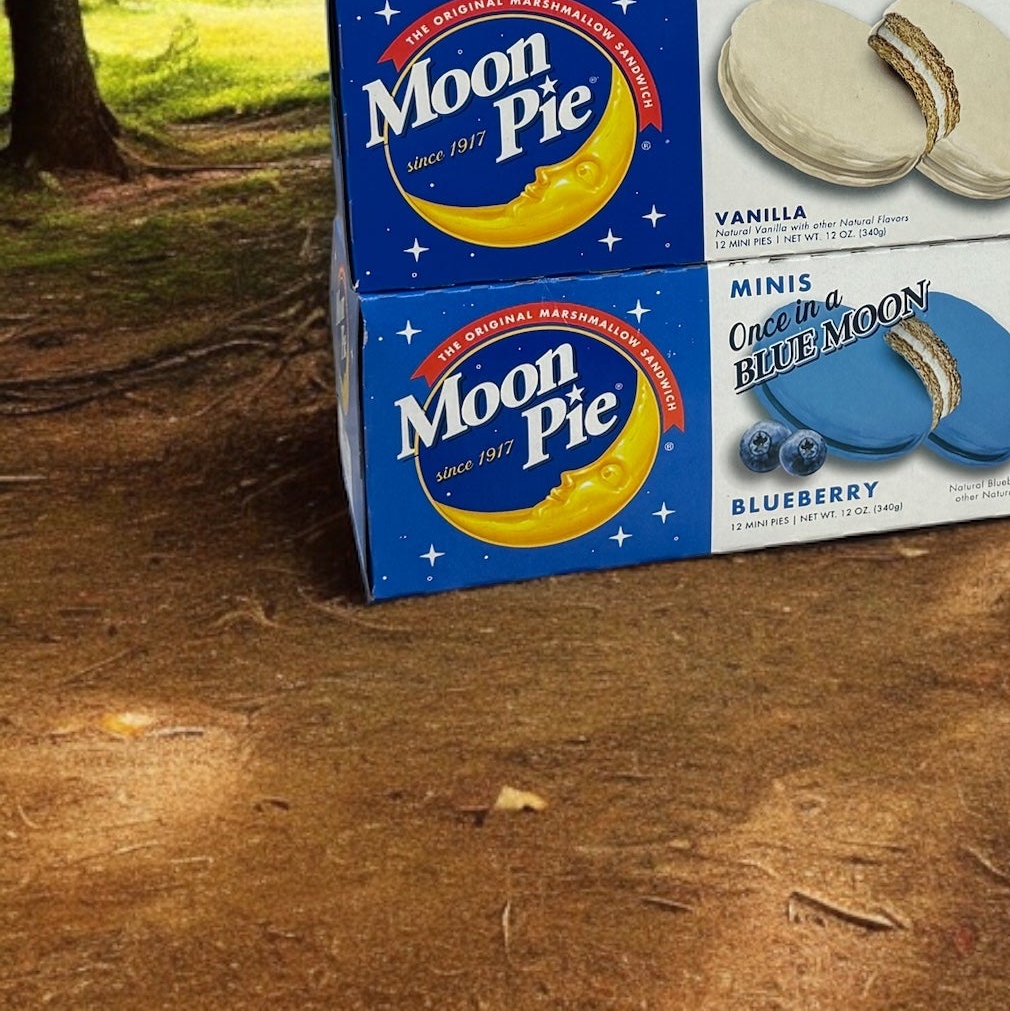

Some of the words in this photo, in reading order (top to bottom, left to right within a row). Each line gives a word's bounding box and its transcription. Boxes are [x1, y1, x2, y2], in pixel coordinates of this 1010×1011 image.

[406, 24, 430, 46] THE
[614, 42, 653, 109] SANDWICH
[362, 32, 551, 148] Moon
[493, 75, 592, 163] Pie
[407, 150, 445, 173] since
[450, 131, 486, 157] 1917
[715, 205, 807, 226] VANILLA
[715, 227, 751, 237] Natural
[755, 224, 787, 234] Vanilla
[791, 222, 810, 232] with
[813, 220, 836, 230] other
[840, 216, 874, 227] Natural
[877, 214, 909, 224] Flavors
[715, 241, 726, 249] 12
[728, 239, 751, 248] MINI
[753, 237, 772, 246] PIES
[784, 234, 801, 243] NET
[804, 232, 822, 241] WT.
[826, 231, 836, 240] 12
[839, 229, 856, 239] OZ.
[859, 227, 886, 238] (340g)
[730, 273, 812, 298] MINIS
[729, 314, 791, 351] Once
[795, 299, 819, 324] in
[826, 289, 843, 310] a
[734, 321, 822, 394] BLUE
[822, 279, 931, 351] MOON
[438, 341, 462, 363] THE
[465, 311, 533, 342] ORIGINAL
[539, 309, 640, 348] MARSHMALLOW
[640, 349, 677, 412] SANDWICH
[394, 343, 578, 461] Moon
[522, 384, 618, 470] Pie
[436, 460, 473, 482] since
[478, 439, 514, 466] 1917
[732, 481, 879, 515] BLUEBERRY
[949, 481, 984, 492] Natural
[956, 493, 978, 502] other
[731, 523, 742, 531] 12
[745, 520, 768, 529] MINI
[771, 516, 789, 526] PIES
[800, 513, 817, 522] NET
[821, 511, 837, 519] WT.
[841, 508, 852, 517] 12
[854, 507, 870, 515] OZ.
[874, 502, 903, 514] (340g)
